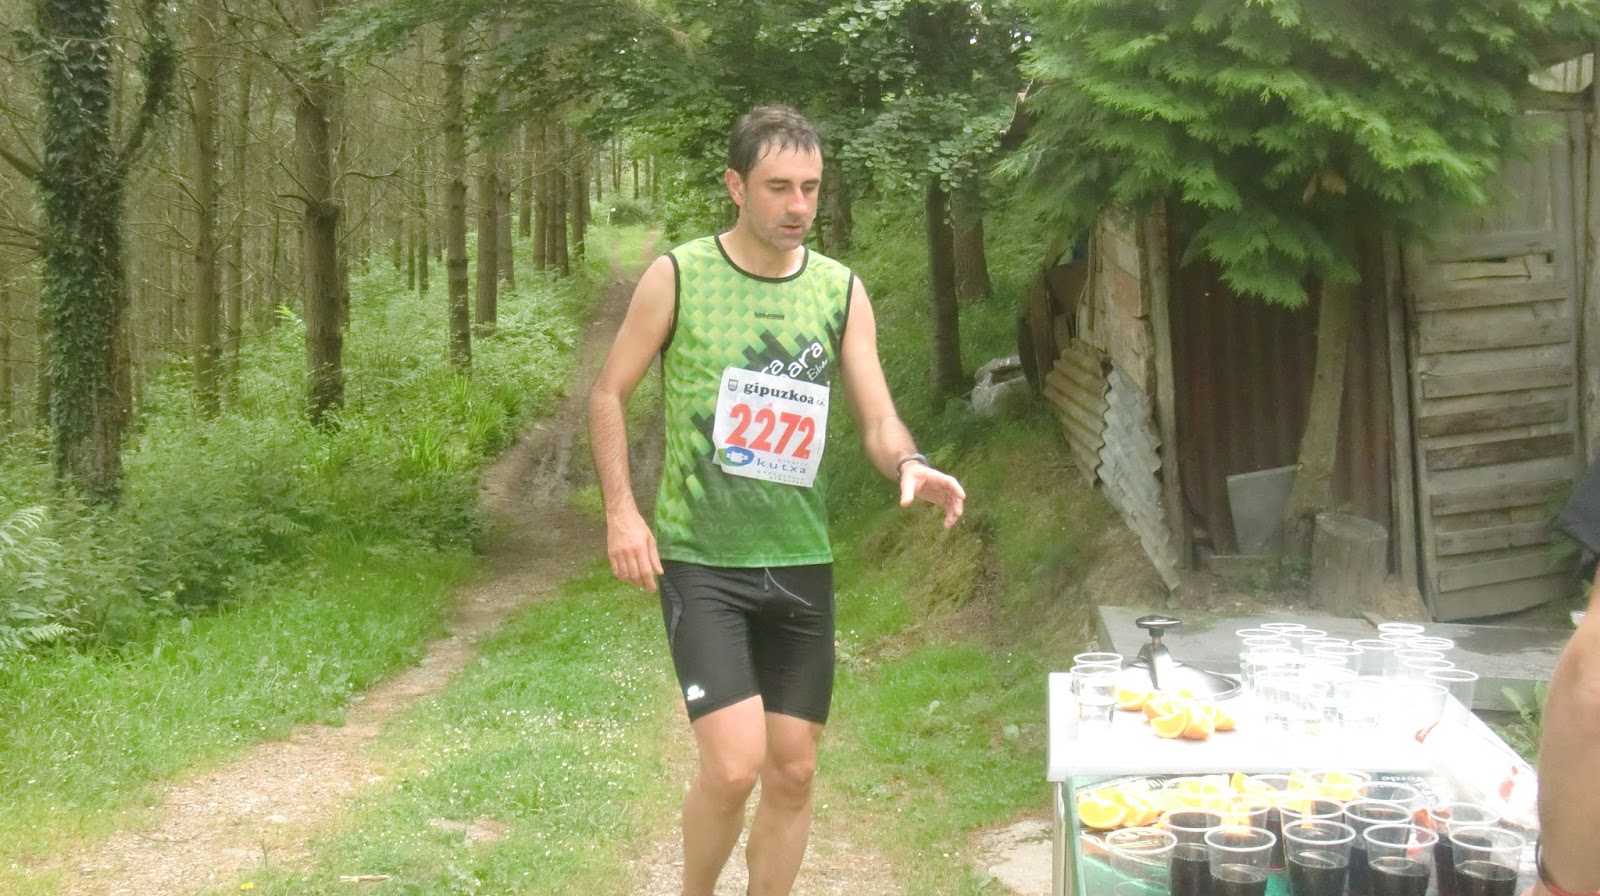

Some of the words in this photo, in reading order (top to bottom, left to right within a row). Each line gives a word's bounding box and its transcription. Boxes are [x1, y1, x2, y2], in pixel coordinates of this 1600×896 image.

[744, 382, 814, 405] gipuzkoa
[725, 403, 816, 460] 2272
[757, 457, 807, 474] kutxa
